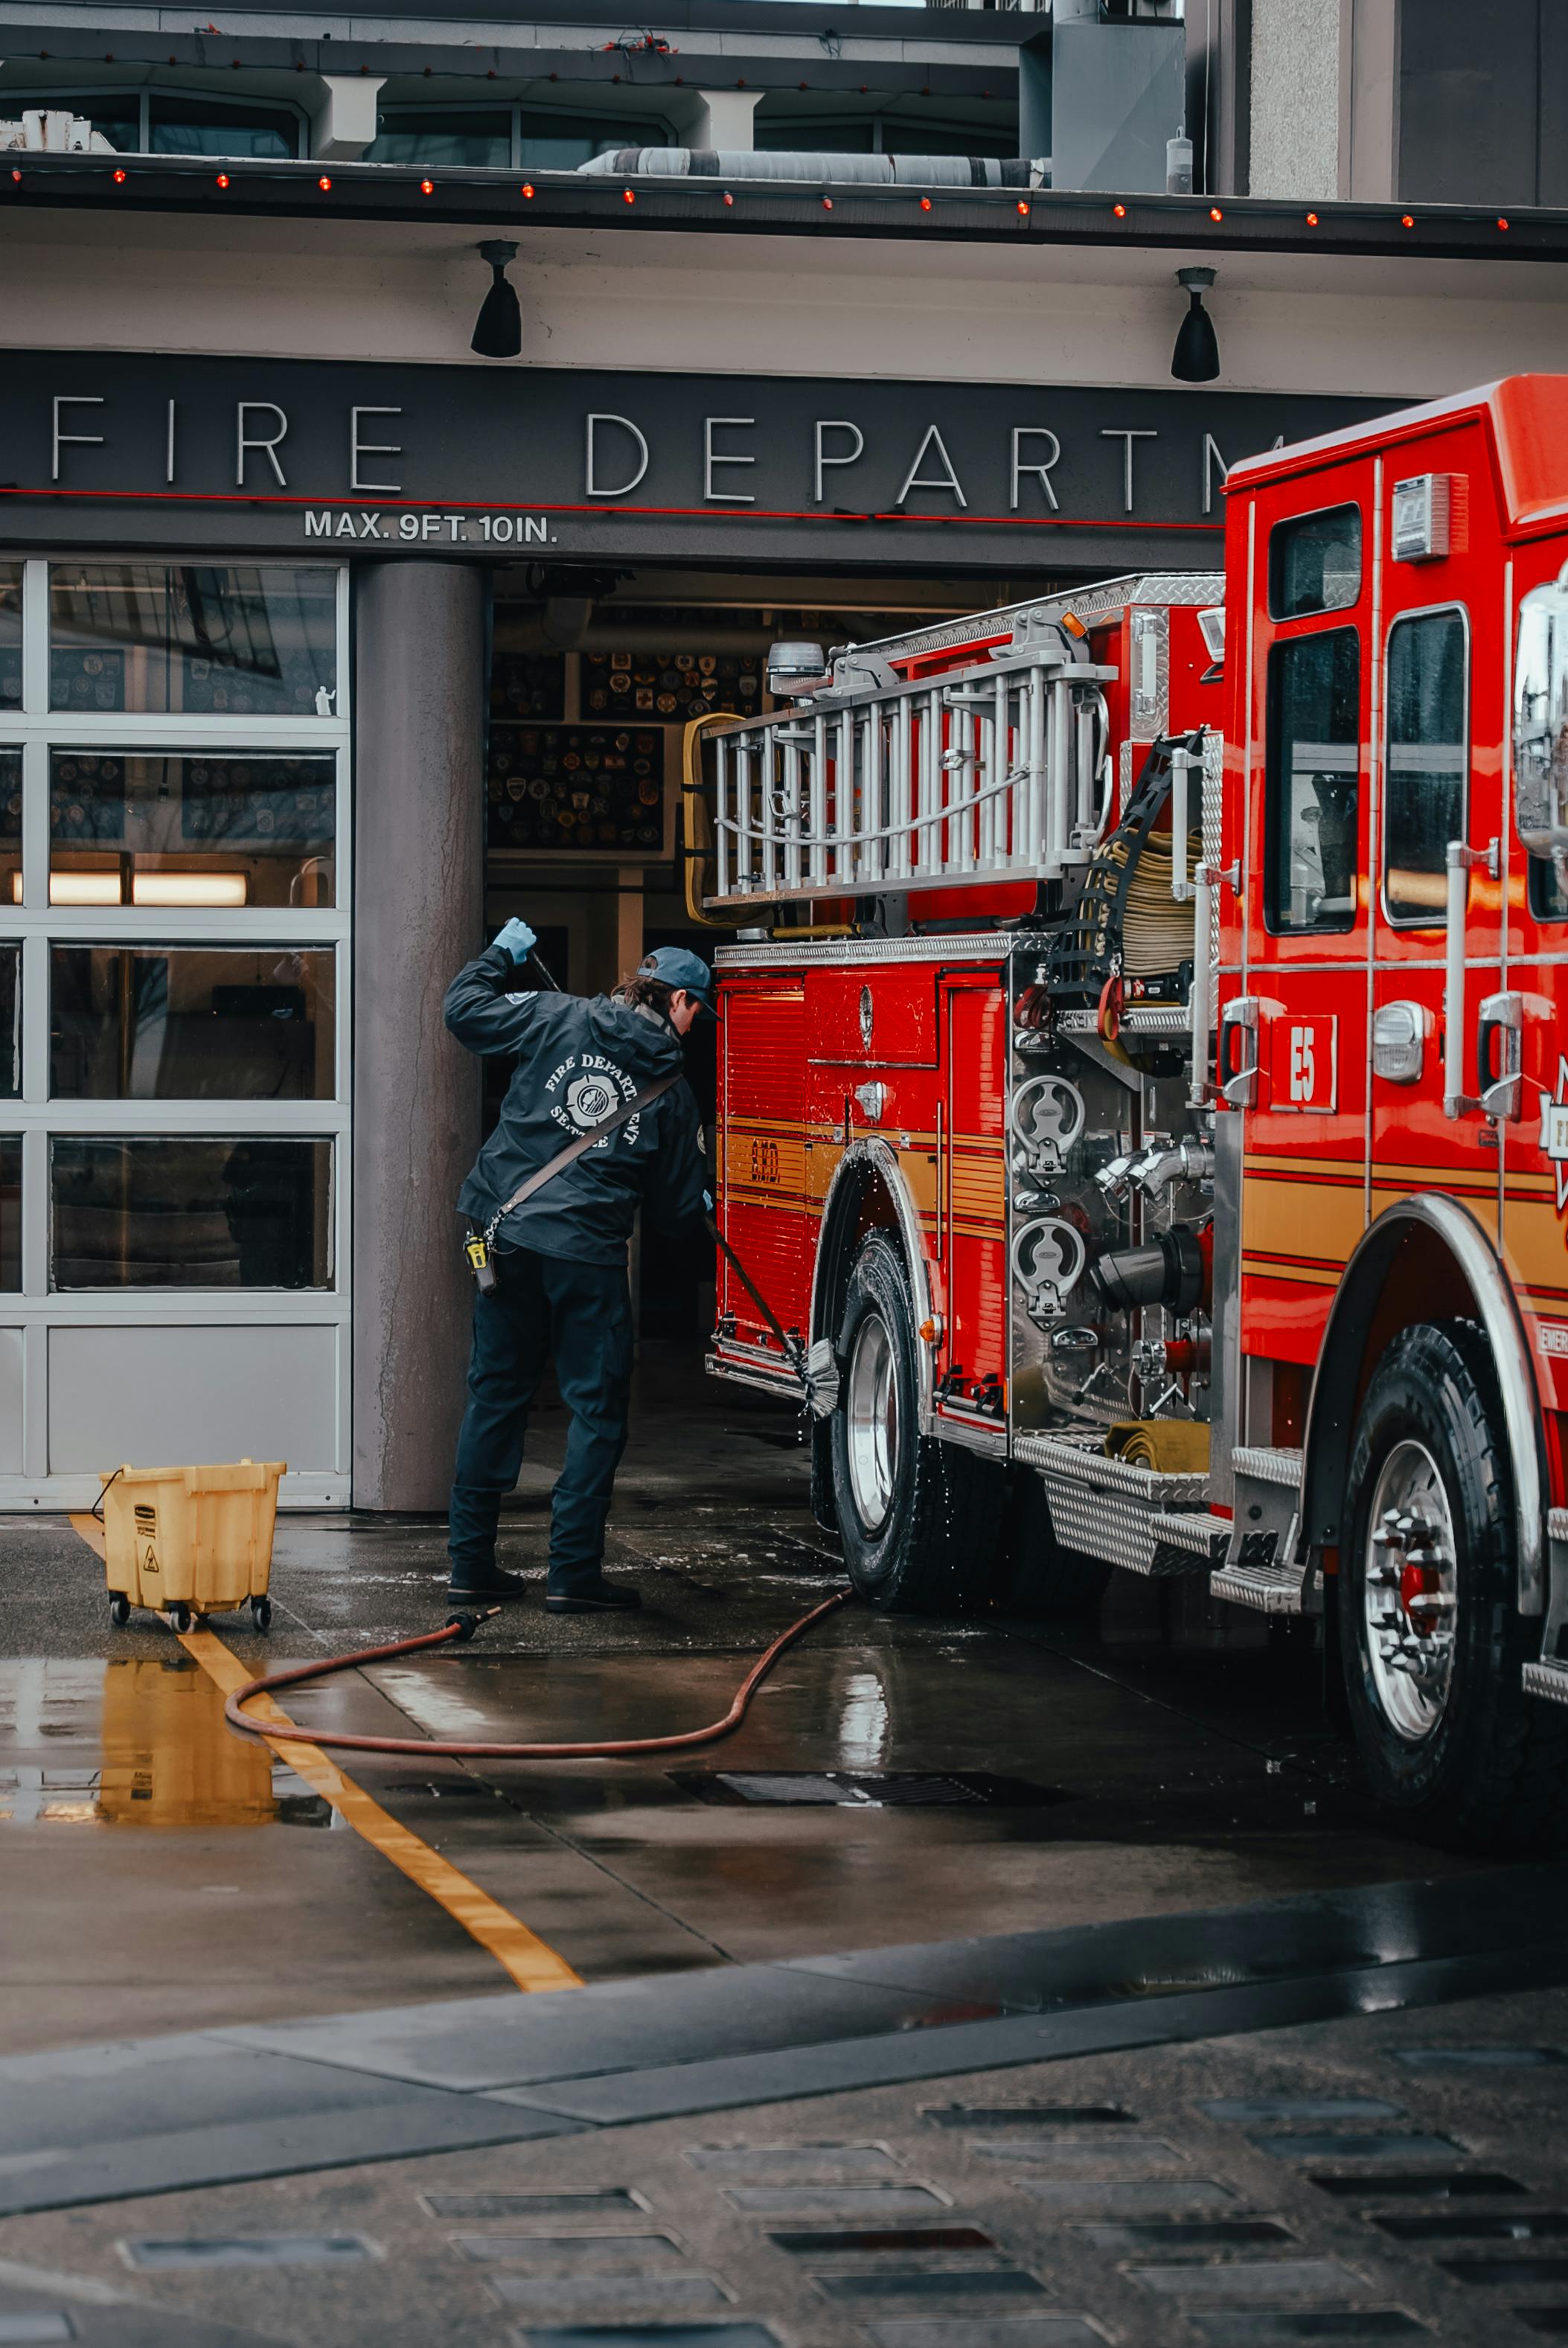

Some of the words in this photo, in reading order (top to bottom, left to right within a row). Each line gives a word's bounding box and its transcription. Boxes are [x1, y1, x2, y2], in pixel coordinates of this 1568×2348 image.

[52, 396, 403, 492] FIRE
[304, 511, 390, 540] MAX.
[399, 514, 467, 543] 9FT.
[479, 515, 558, 543] 10IN.
[545, 1056, 576, 1093] FIRE
[581, 1054, 640, 1145] DEPARTENT
[1290, 1026, 1315, 1102] E5
[550, 1105, 609, 1148] SETE
